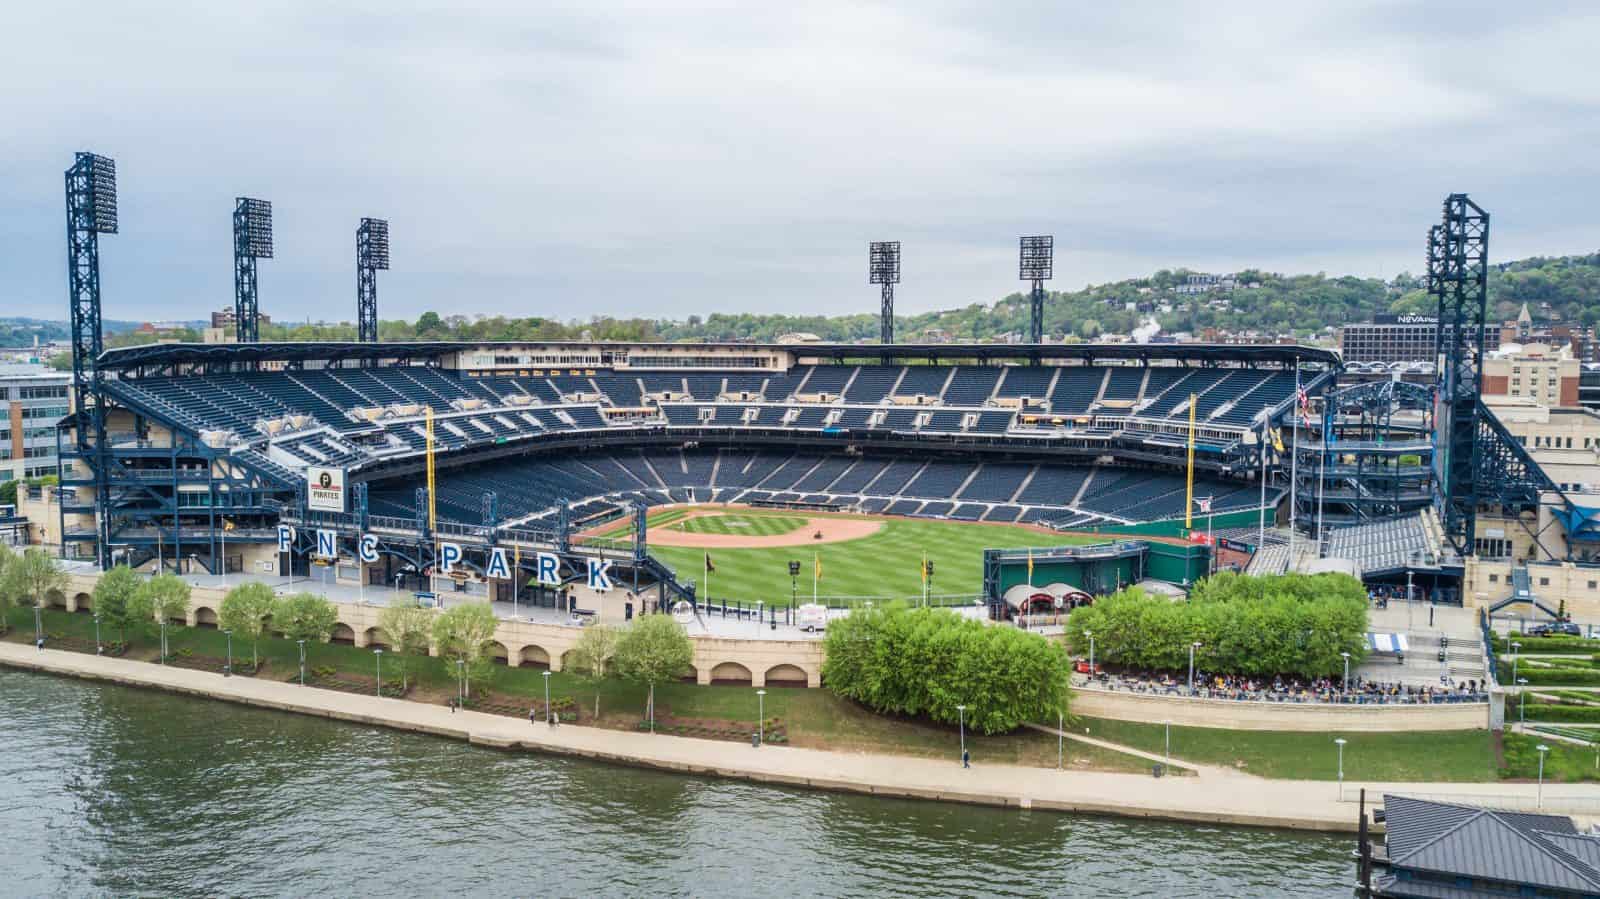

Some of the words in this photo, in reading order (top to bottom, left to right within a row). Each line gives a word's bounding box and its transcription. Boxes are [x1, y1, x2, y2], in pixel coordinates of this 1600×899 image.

[313, 490, 340, 500] PIRATES
[278, 524, 380, 562] PNC
[440, 541, 613, 592] PARK
